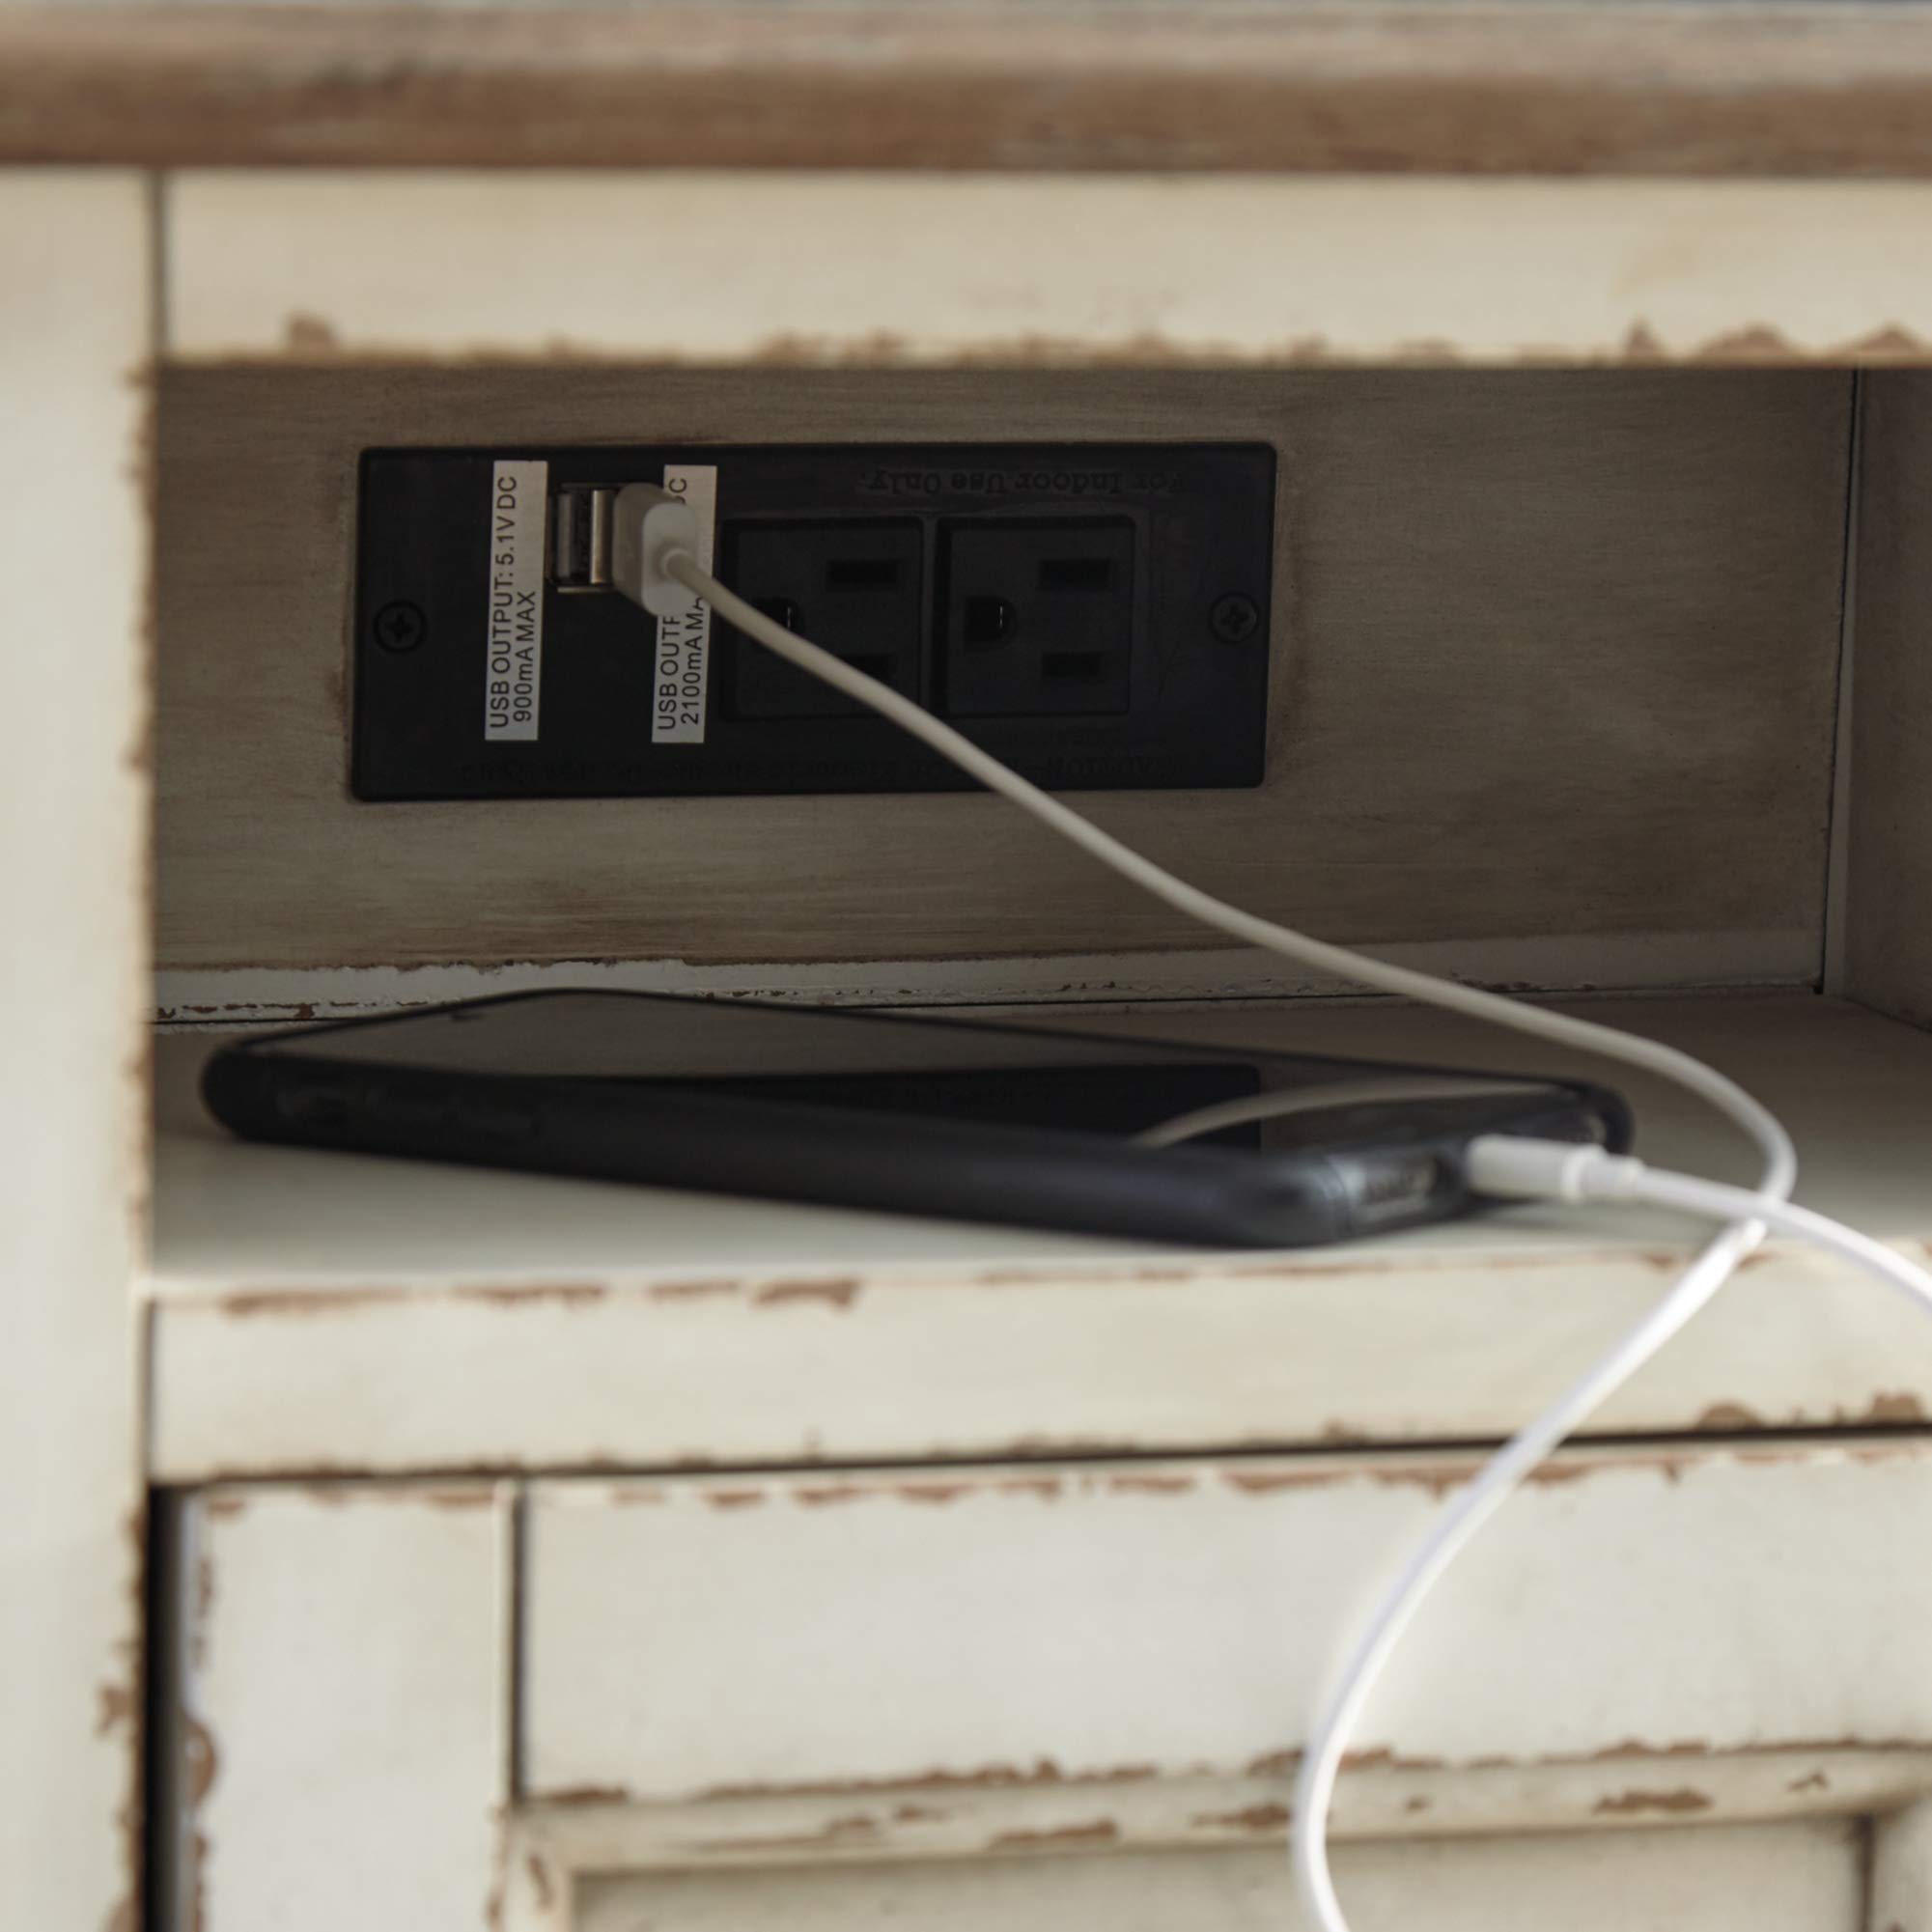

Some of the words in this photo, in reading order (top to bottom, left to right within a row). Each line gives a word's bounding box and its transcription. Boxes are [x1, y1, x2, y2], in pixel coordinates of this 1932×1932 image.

[951, 471, 1006, 495] Use
[1015, 471, 1122, 495] Indoor
[492, 572, 513, 674] OUTPUT:
[490, 681, 510, 728] USB
[658, 684, 677, 730] USB
